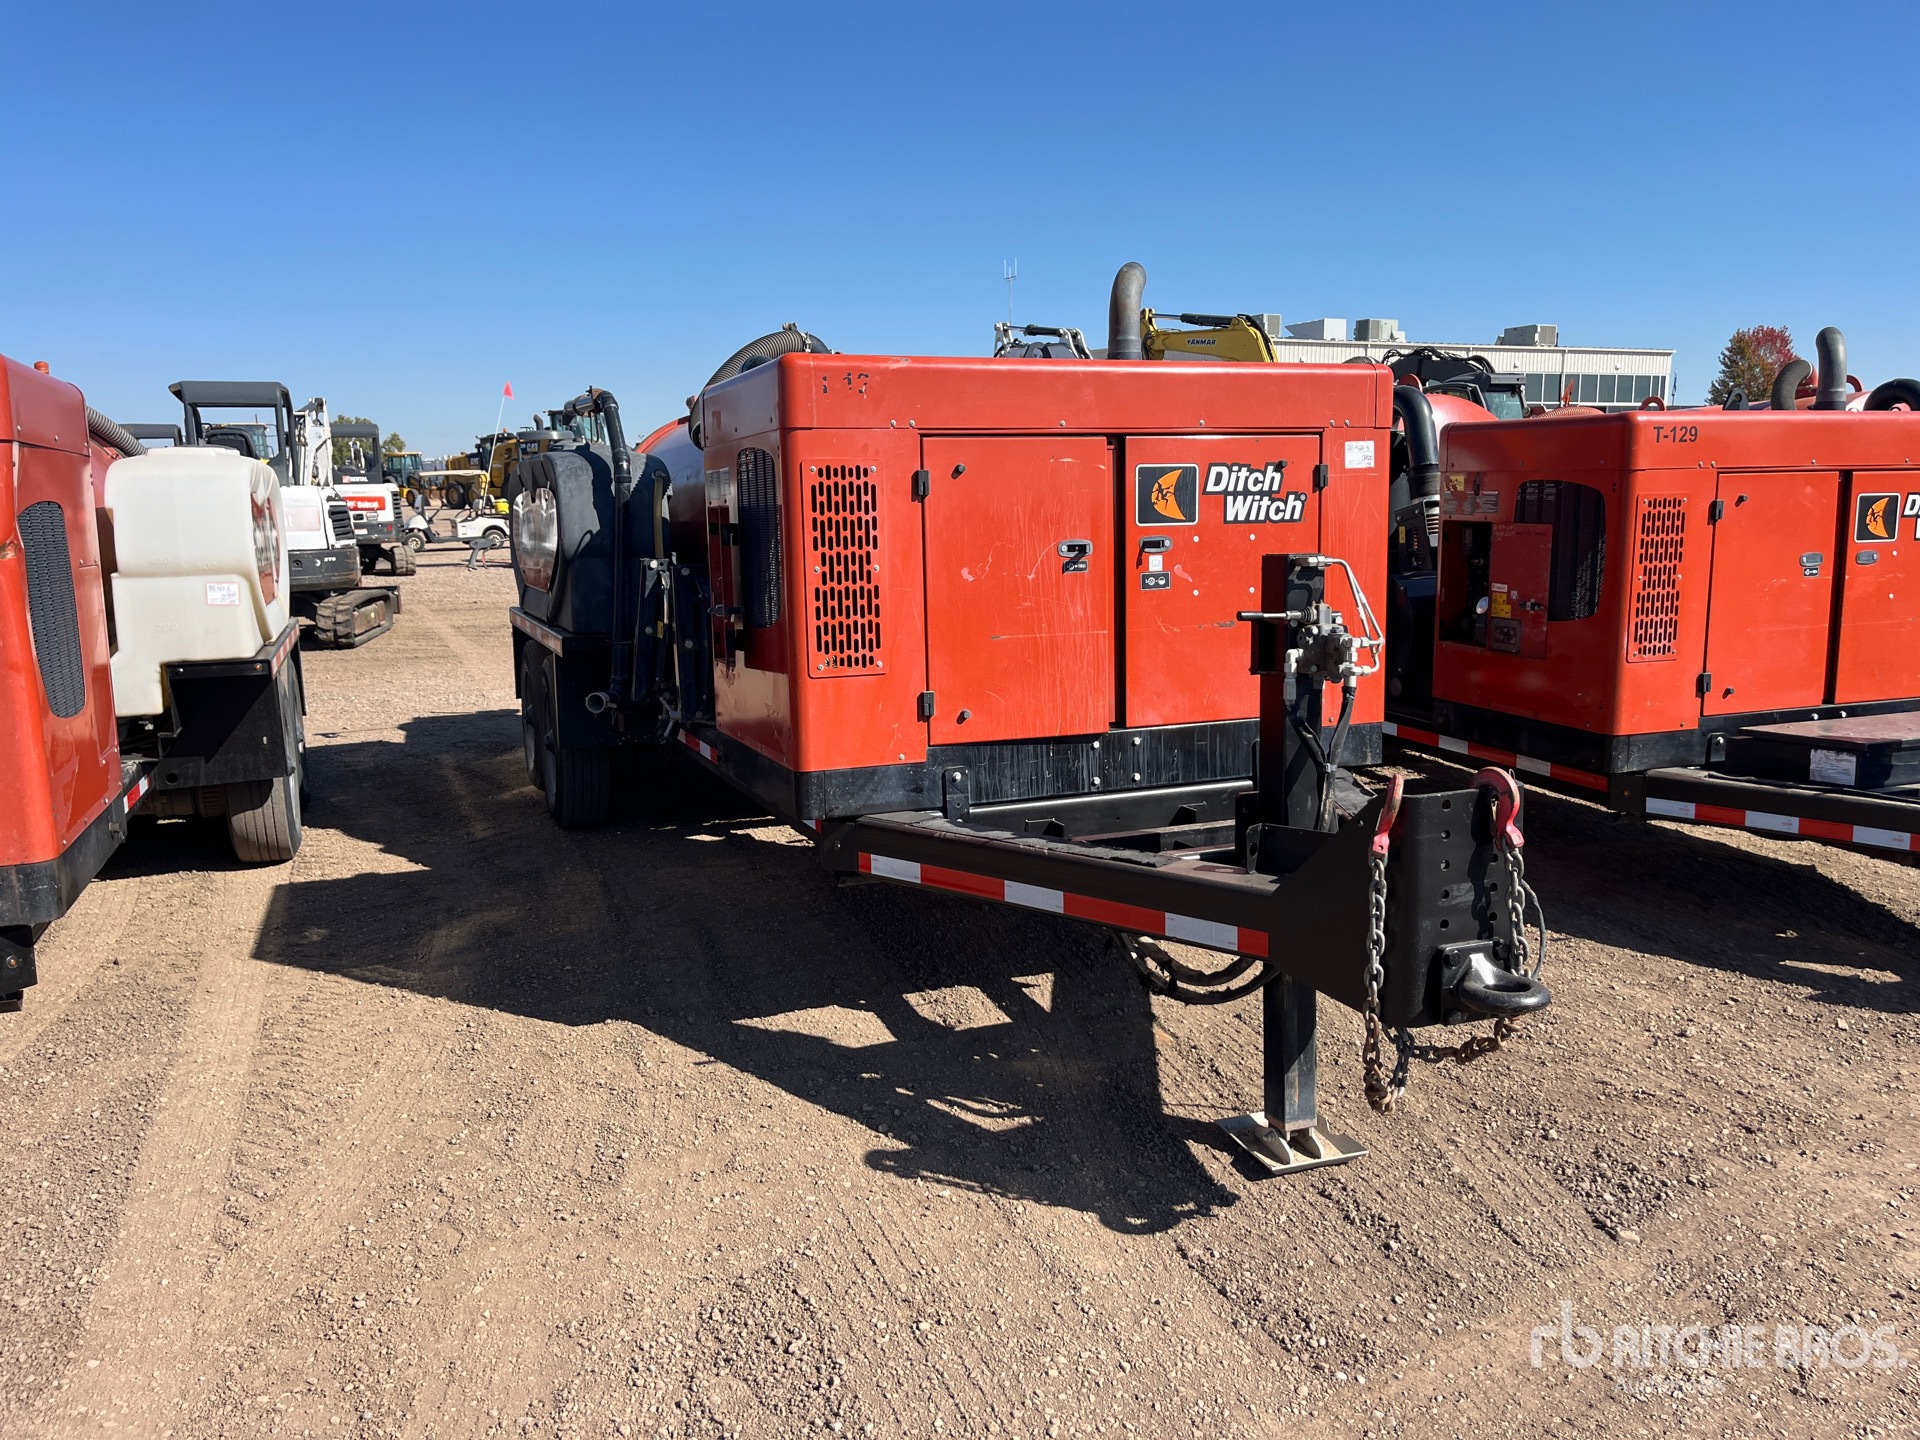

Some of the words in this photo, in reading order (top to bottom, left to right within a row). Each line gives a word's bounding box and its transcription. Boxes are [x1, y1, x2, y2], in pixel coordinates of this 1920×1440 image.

[1653, 425, 1699, 443] T-129
[1205, 465, 1282, 493] Ditch
[1226, 494, 1304, 522] Witch
